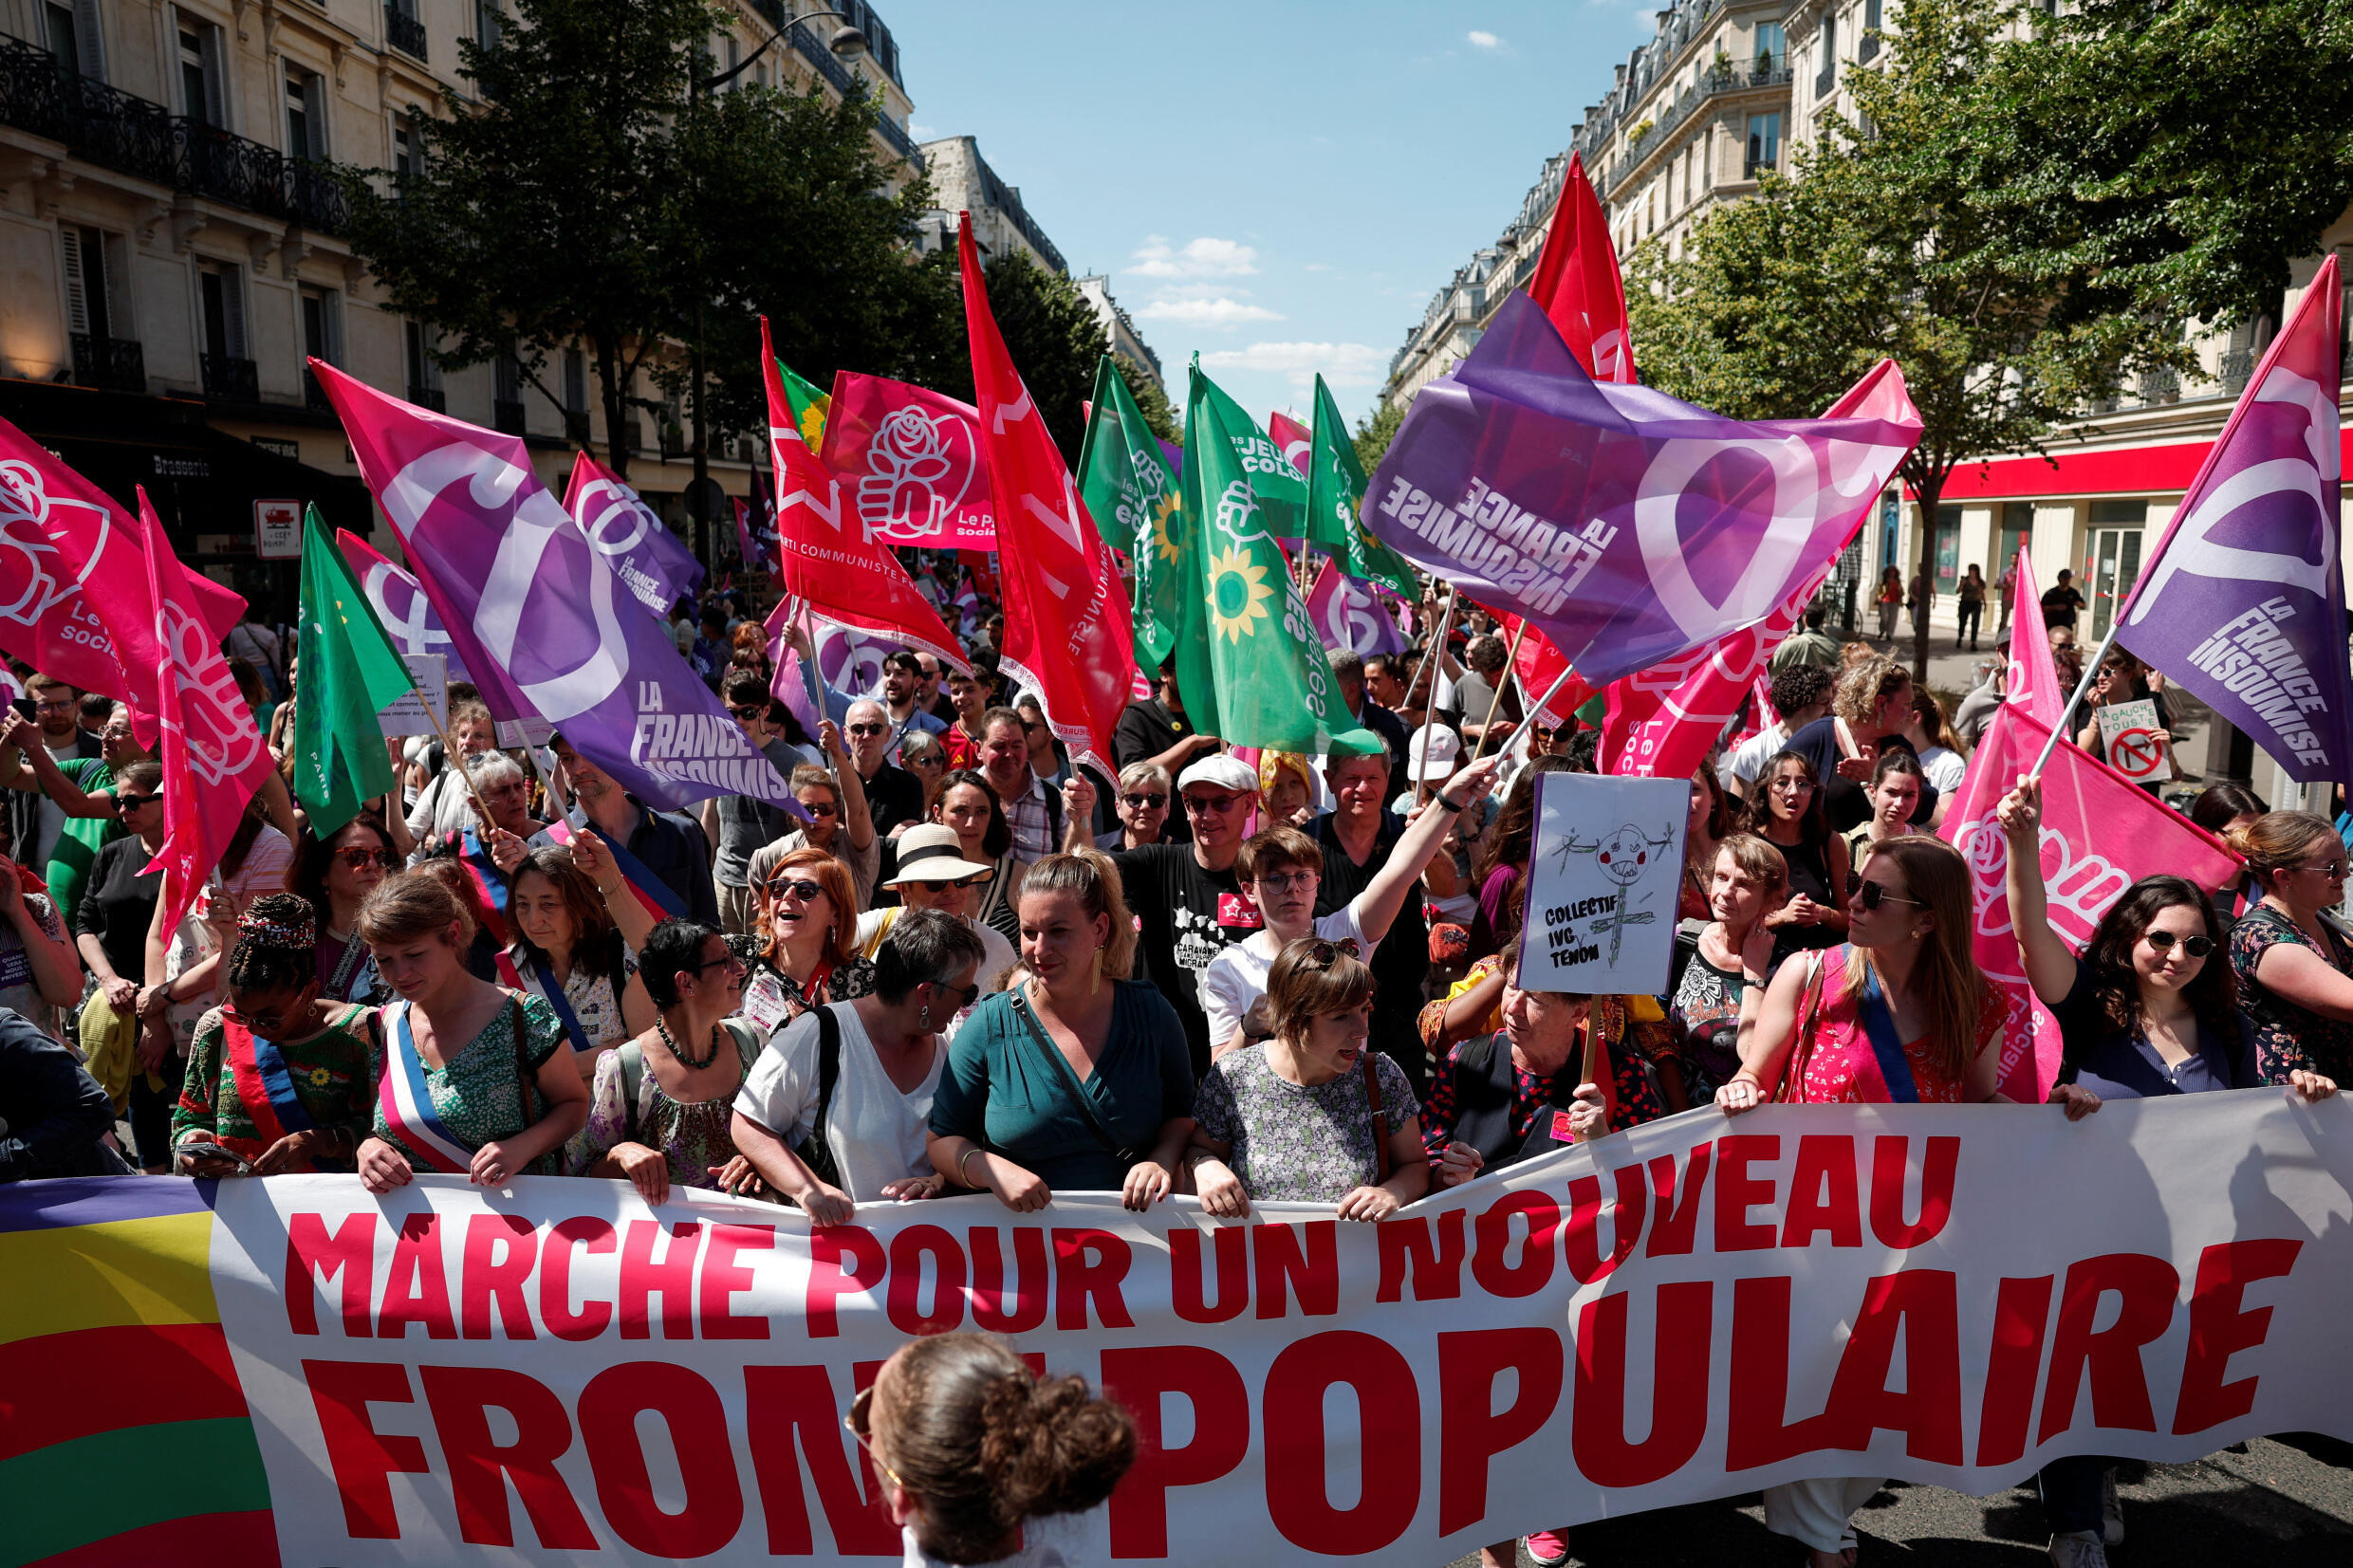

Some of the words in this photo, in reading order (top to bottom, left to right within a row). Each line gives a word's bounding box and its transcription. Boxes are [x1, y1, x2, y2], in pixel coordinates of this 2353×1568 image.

[154, 455, 211, 476] Brasserie
[624, 555, 636, 567] LA
[801, 543, 897, 581] COMMUNISTE
[618, 562, 660, 594] FRANCE
[2259, 595, 2297, 623] LA
[2213, 606, 2329, 714] FRANCE
[639, 680, 663, 712] LA
[2186, 636, 2330, 766] INSOUMISE
[630, 713, 752, 766] FRANCE
[310, 751, 330, 800] PARIS
[1241, 912, 1258, 920] PCF
[1545, 895, 1619, 927] COLLECTIF
[1548, 927, 1575, 949] IVG
[1550, 944, 1600, 968] TENON
[285, 1212, 775, 1341] MARCHE
[806, 1224, 1135, 1338] POUR
[1168, 1220, 1338, 1323] UN
[1377, 1134, 1960, 1303] NOUVEAU
[302, 1353, 1047, 1559] FRON
[1101, 1238, 2303, 1559] POPULAIRE
